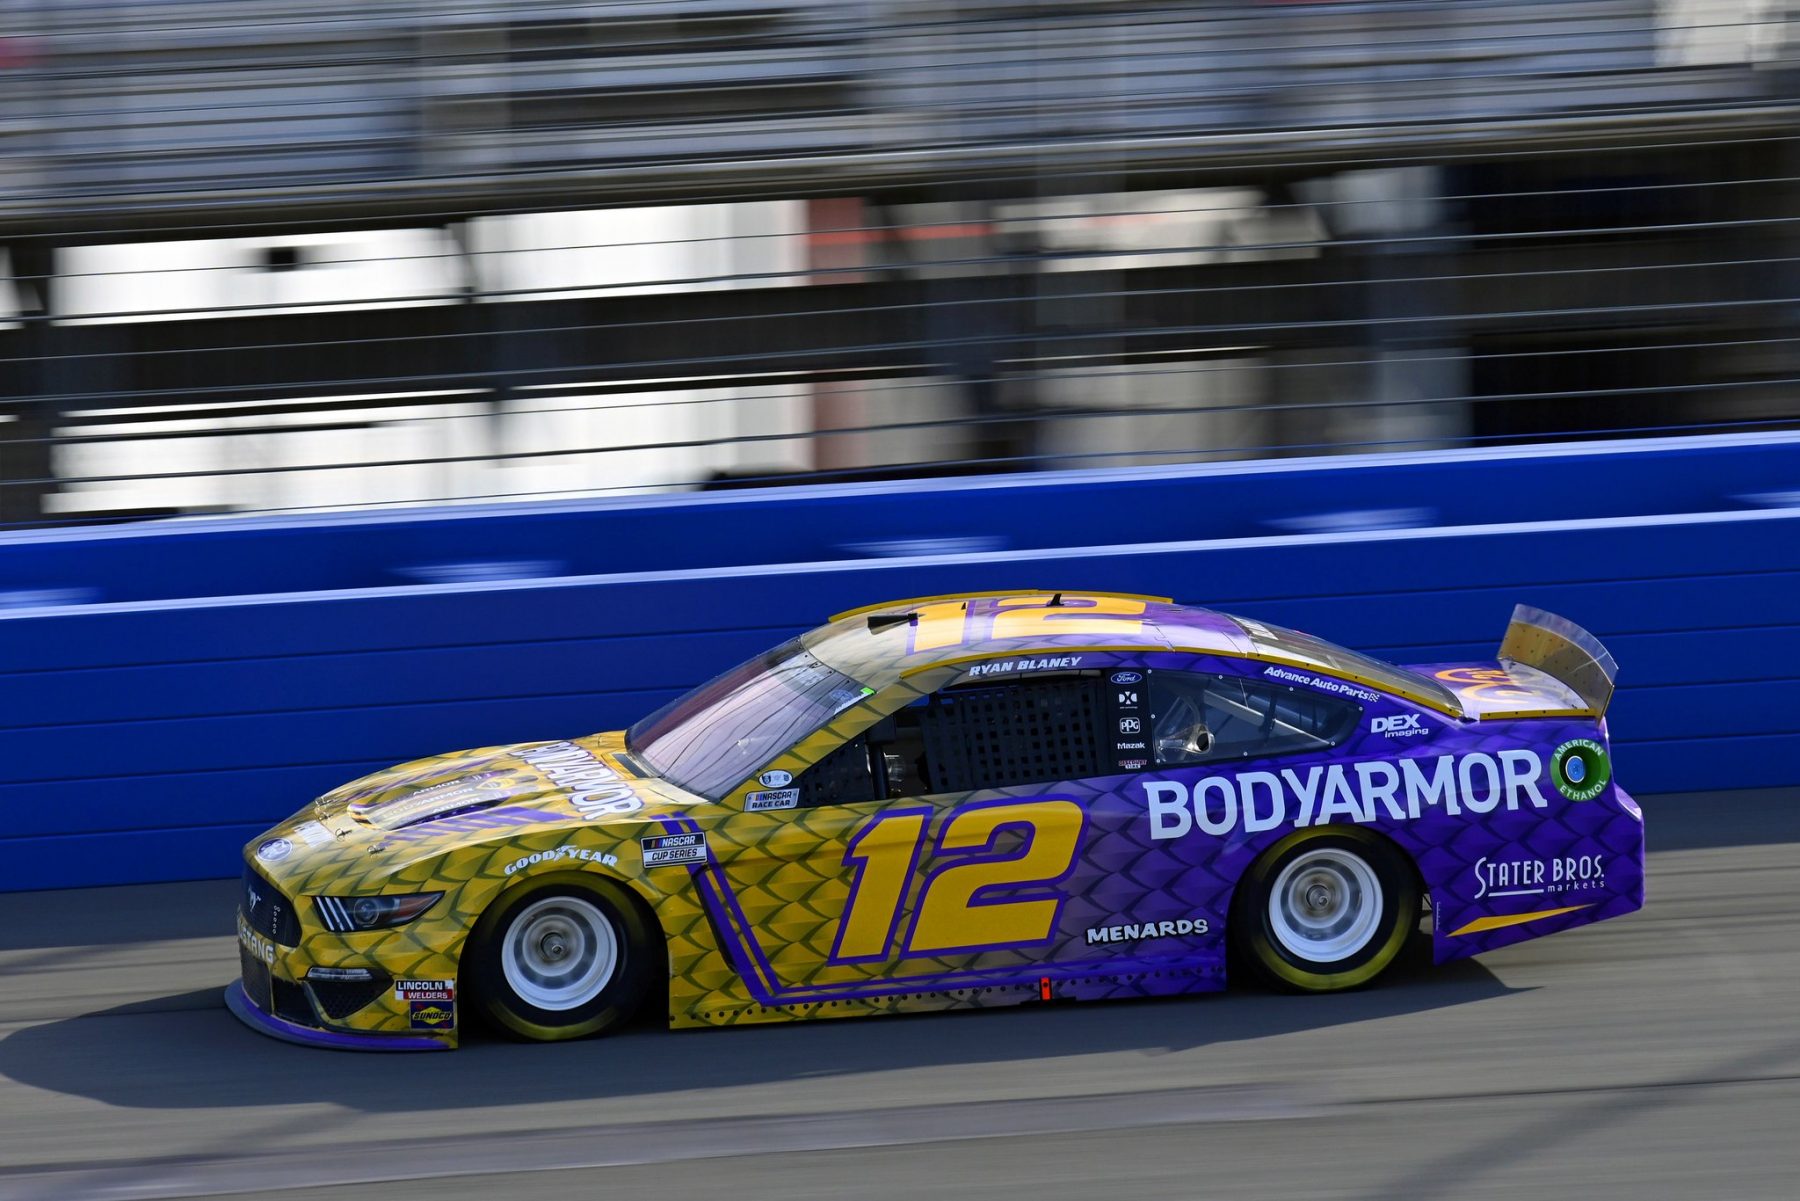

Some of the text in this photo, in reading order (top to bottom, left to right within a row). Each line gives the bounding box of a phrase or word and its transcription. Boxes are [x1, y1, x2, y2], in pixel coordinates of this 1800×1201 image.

[907, 596, 1147, 653] 12
[969, 656, 1082, 677] RYAN BLANEY
[1116, 673, 1136, 682] Ford
[1264, 666, 1369, 700] Advance Auto Parts
[1121, 719, 1139, 732] PPG
[1371, 713, 1420, 734] DEX
[1385, 727, 1429, 738] imaging
[1117, 742, 1146, 750] Mazak
[1554, 739, 1604, 760] AMERICAN
[762, 791, 792, 800] NASCAR
[1143, 749, 1548, 840] BODYARMOR
[1560, 779, 1607, 800] ETHANOL
[752, 801, 773, 809] RACE
[661, 835, 696, 847] NASCAR
[504, 845, 618, 876] GOODYEAR
[651, 848, 698, 861] CUP SERIES
[832, 797, 1084, 963] 12
[1474, 854, 1605, 900] STATER BROS.
[1547, 880, 1605, 893] markets
[1086, 918, 1209, 945] MENARDS
[398, 981, 443, 991] LINCOLN
[408, 991, 448, 999] WELDERS
[413, 1012, 451, 1020] SUNOCO
